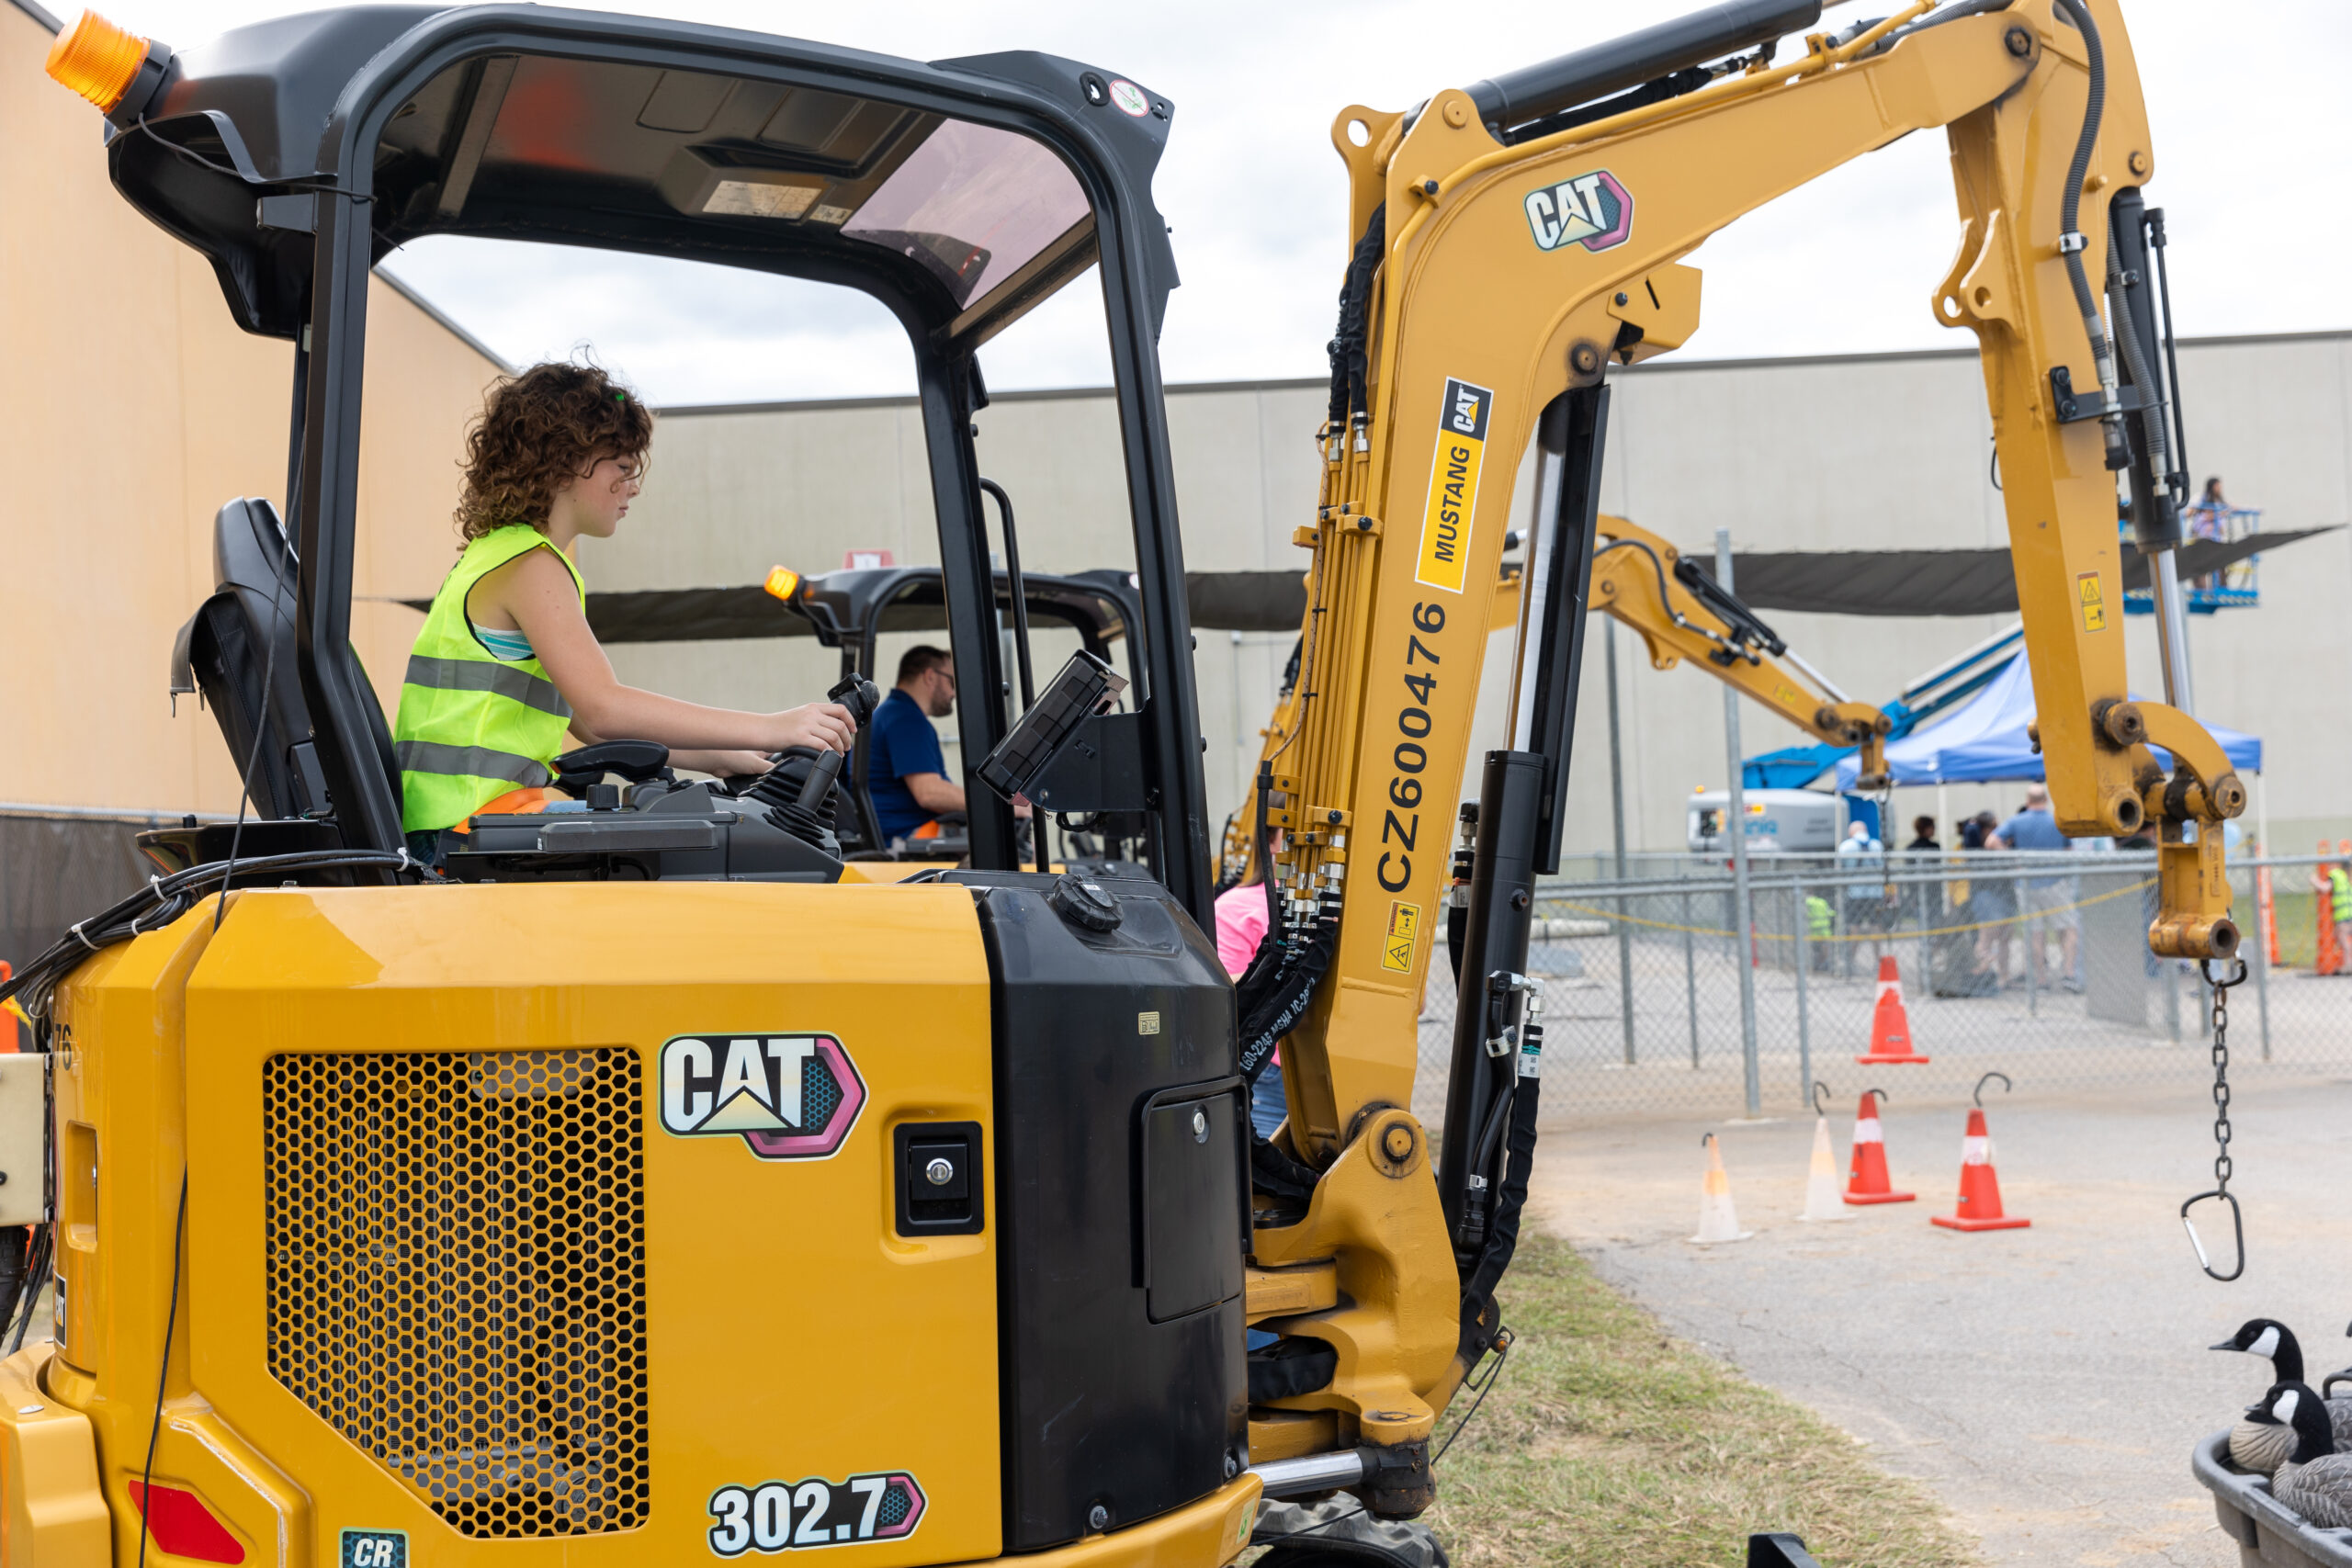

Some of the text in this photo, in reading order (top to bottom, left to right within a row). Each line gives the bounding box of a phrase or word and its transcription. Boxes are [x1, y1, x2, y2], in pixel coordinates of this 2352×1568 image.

[1526, 174, 1607, 249] CAT
[1453, 388, 1479, 433] CAT
[1434, 446, 1470, 563] MUSTANG
[1377, 602, 1445, 893] CZ600476
[663, 1038, 815, 1132] CAT
[354, 1538, 394, 1568] CR
[713, 1477, 888, 1553] 302.7
